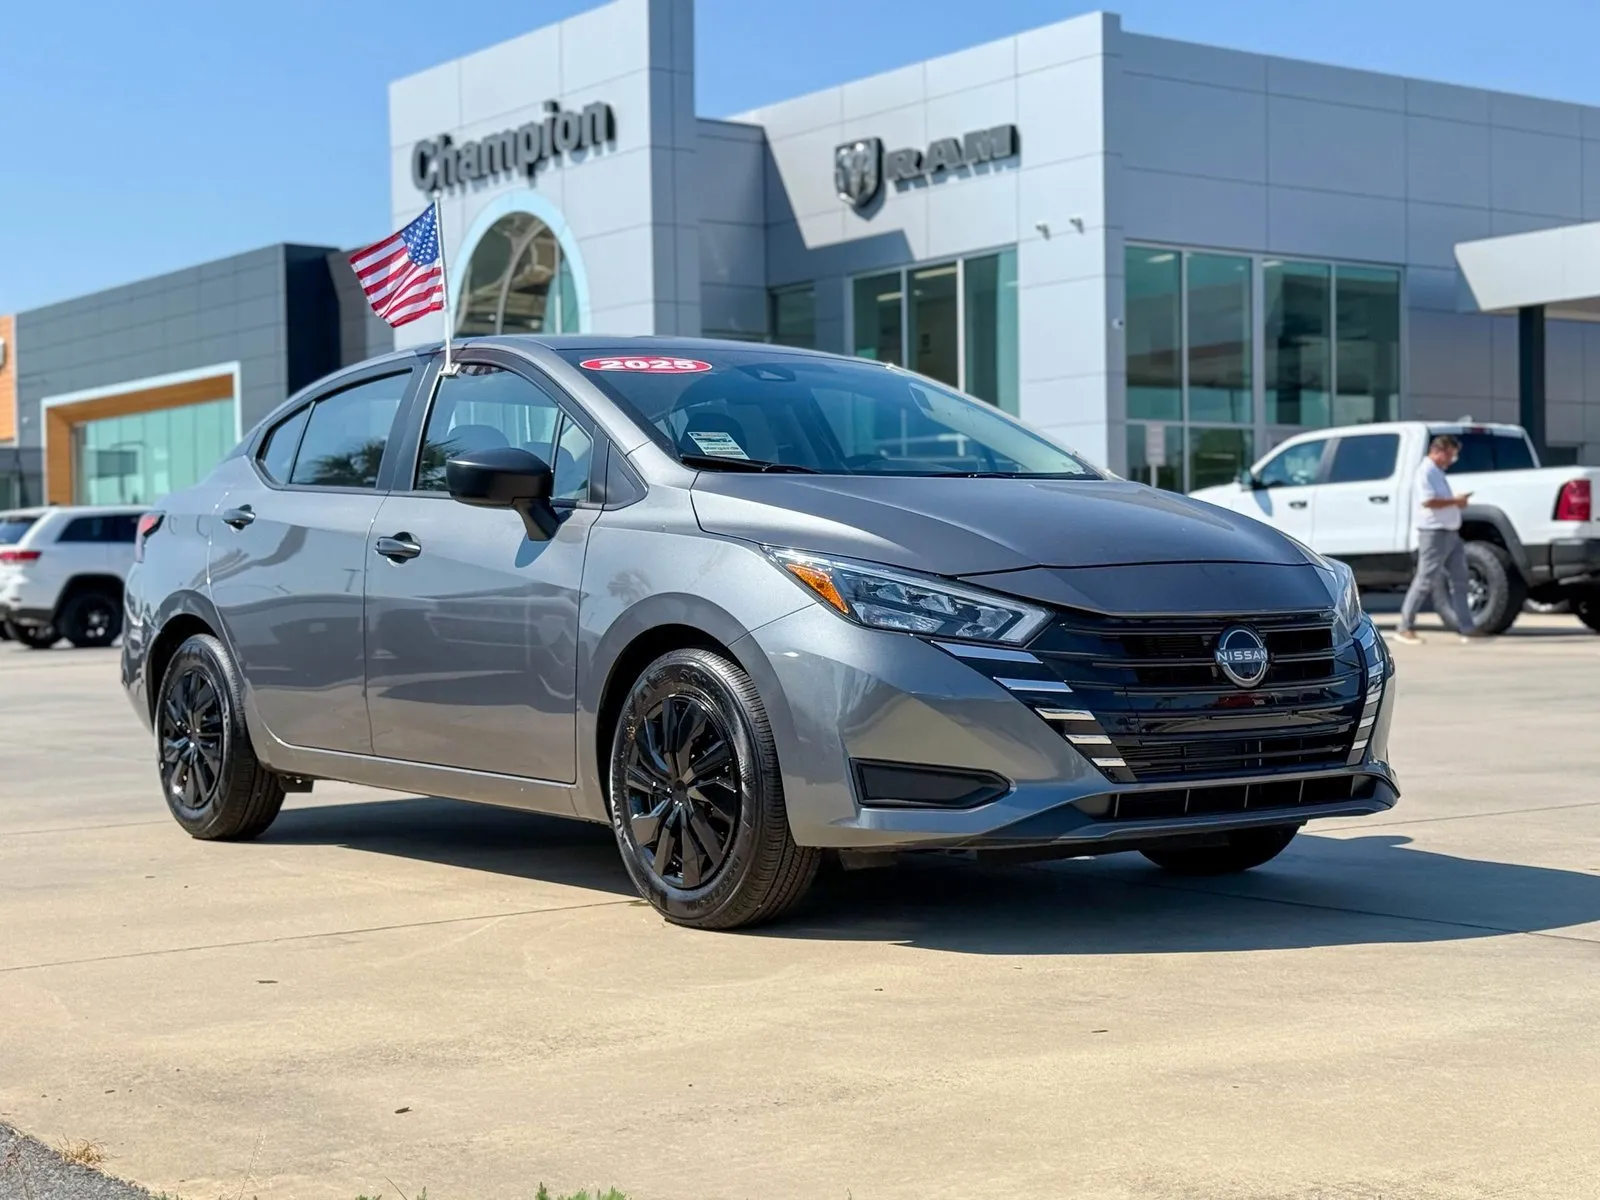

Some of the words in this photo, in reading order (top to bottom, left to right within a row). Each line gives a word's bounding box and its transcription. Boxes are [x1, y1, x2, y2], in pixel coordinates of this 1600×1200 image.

[412, 99, 615, 192] Champion
[886, 123, 1020, 181] RAM
[599, 360, 697, 370] 2025
[1216, 650, 1267, 661] NISSAN
